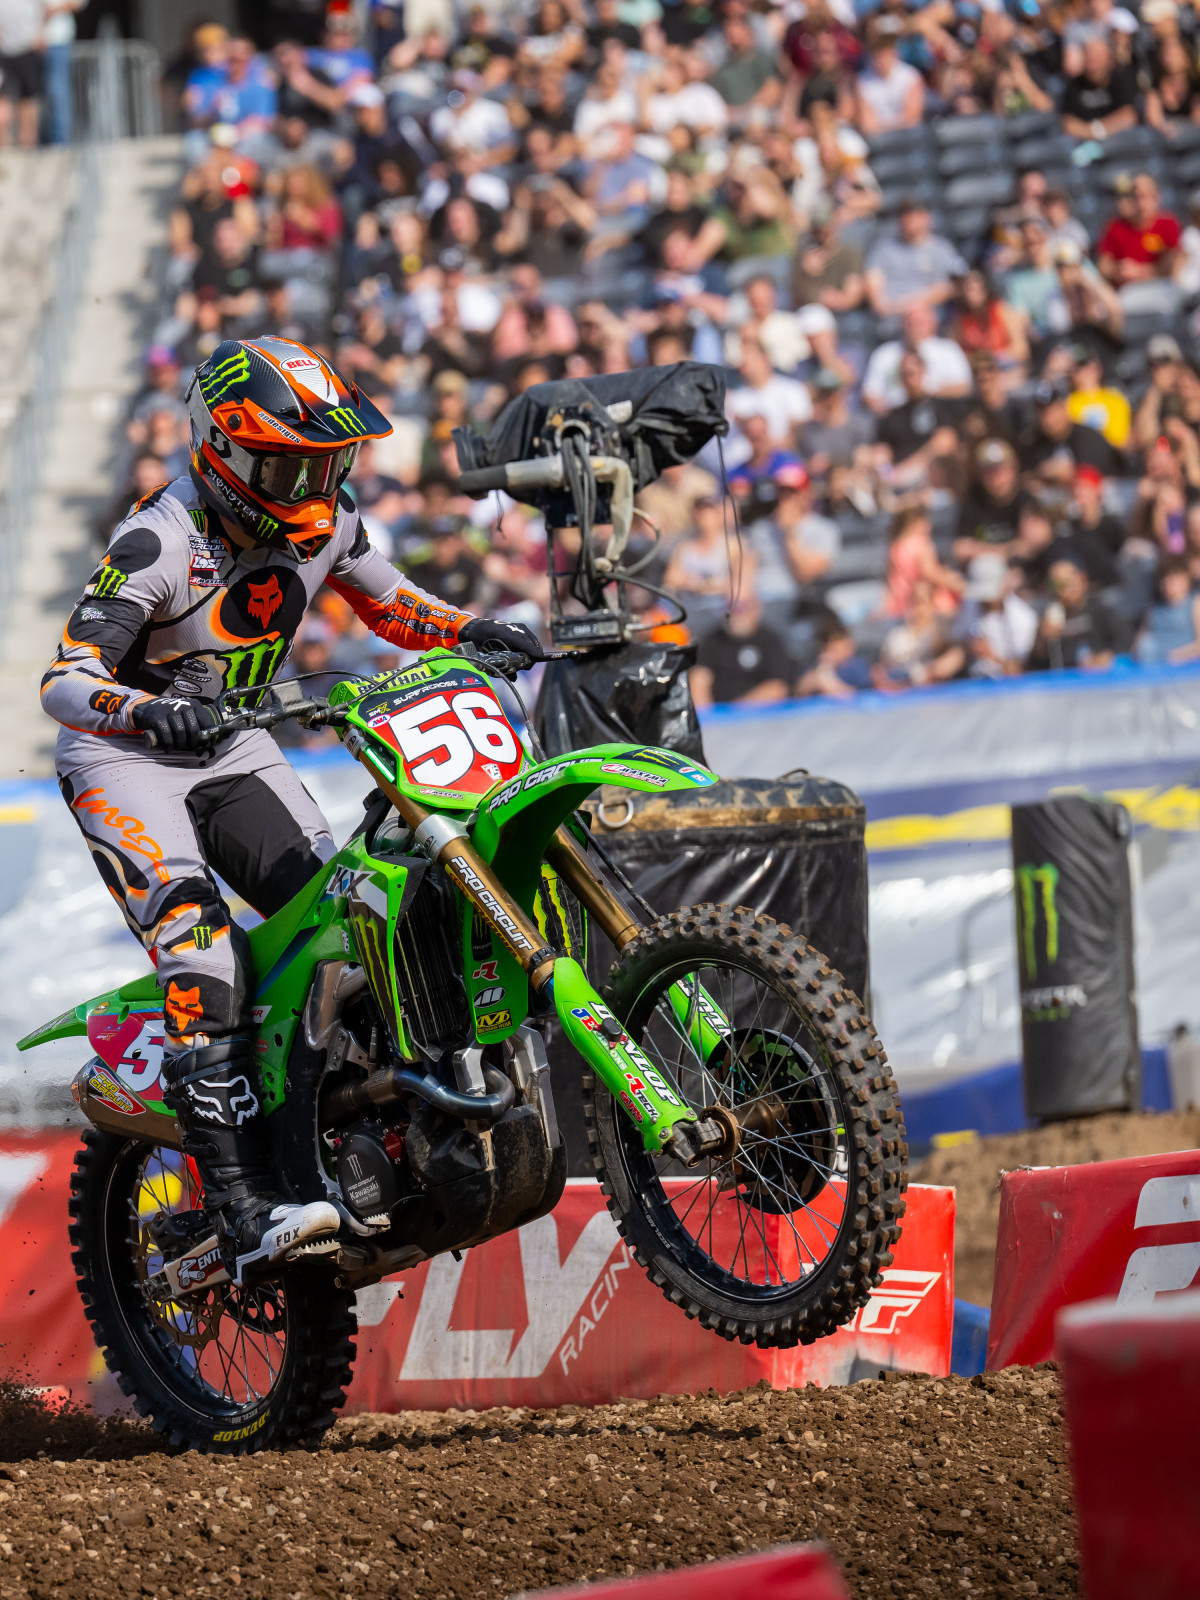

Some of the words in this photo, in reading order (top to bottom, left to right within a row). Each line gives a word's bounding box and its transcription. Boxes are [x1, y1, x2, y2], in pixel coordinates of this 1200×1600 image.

[286, 358, 317, 369] BELL
[208, 468, 257, 521] MONSTER
[388, 691, 518, 788] 56
[489, 779, 523, 813] PRO
[326, 864, 372, 901] KX
[450, 855, 486, 892] PRO
[477, 889, 535, 951] CIRCUIT
[115, 1019, 167, 1093] 5
[587, 1000, 681, 1107] DNLOP
[89, 1077, 133, 1112] CIRCUIT
[96, 1073, 119, 1094] PRO
[635, 1089, 660, 1118] TECH
[349, 1180, 380, 1201] Kawasaki
[275, 1226, 301, 1248] FOX
[559, 1244, 636, 1377] RACIN
[212, 1412, 266, 1442] DUNLOP
